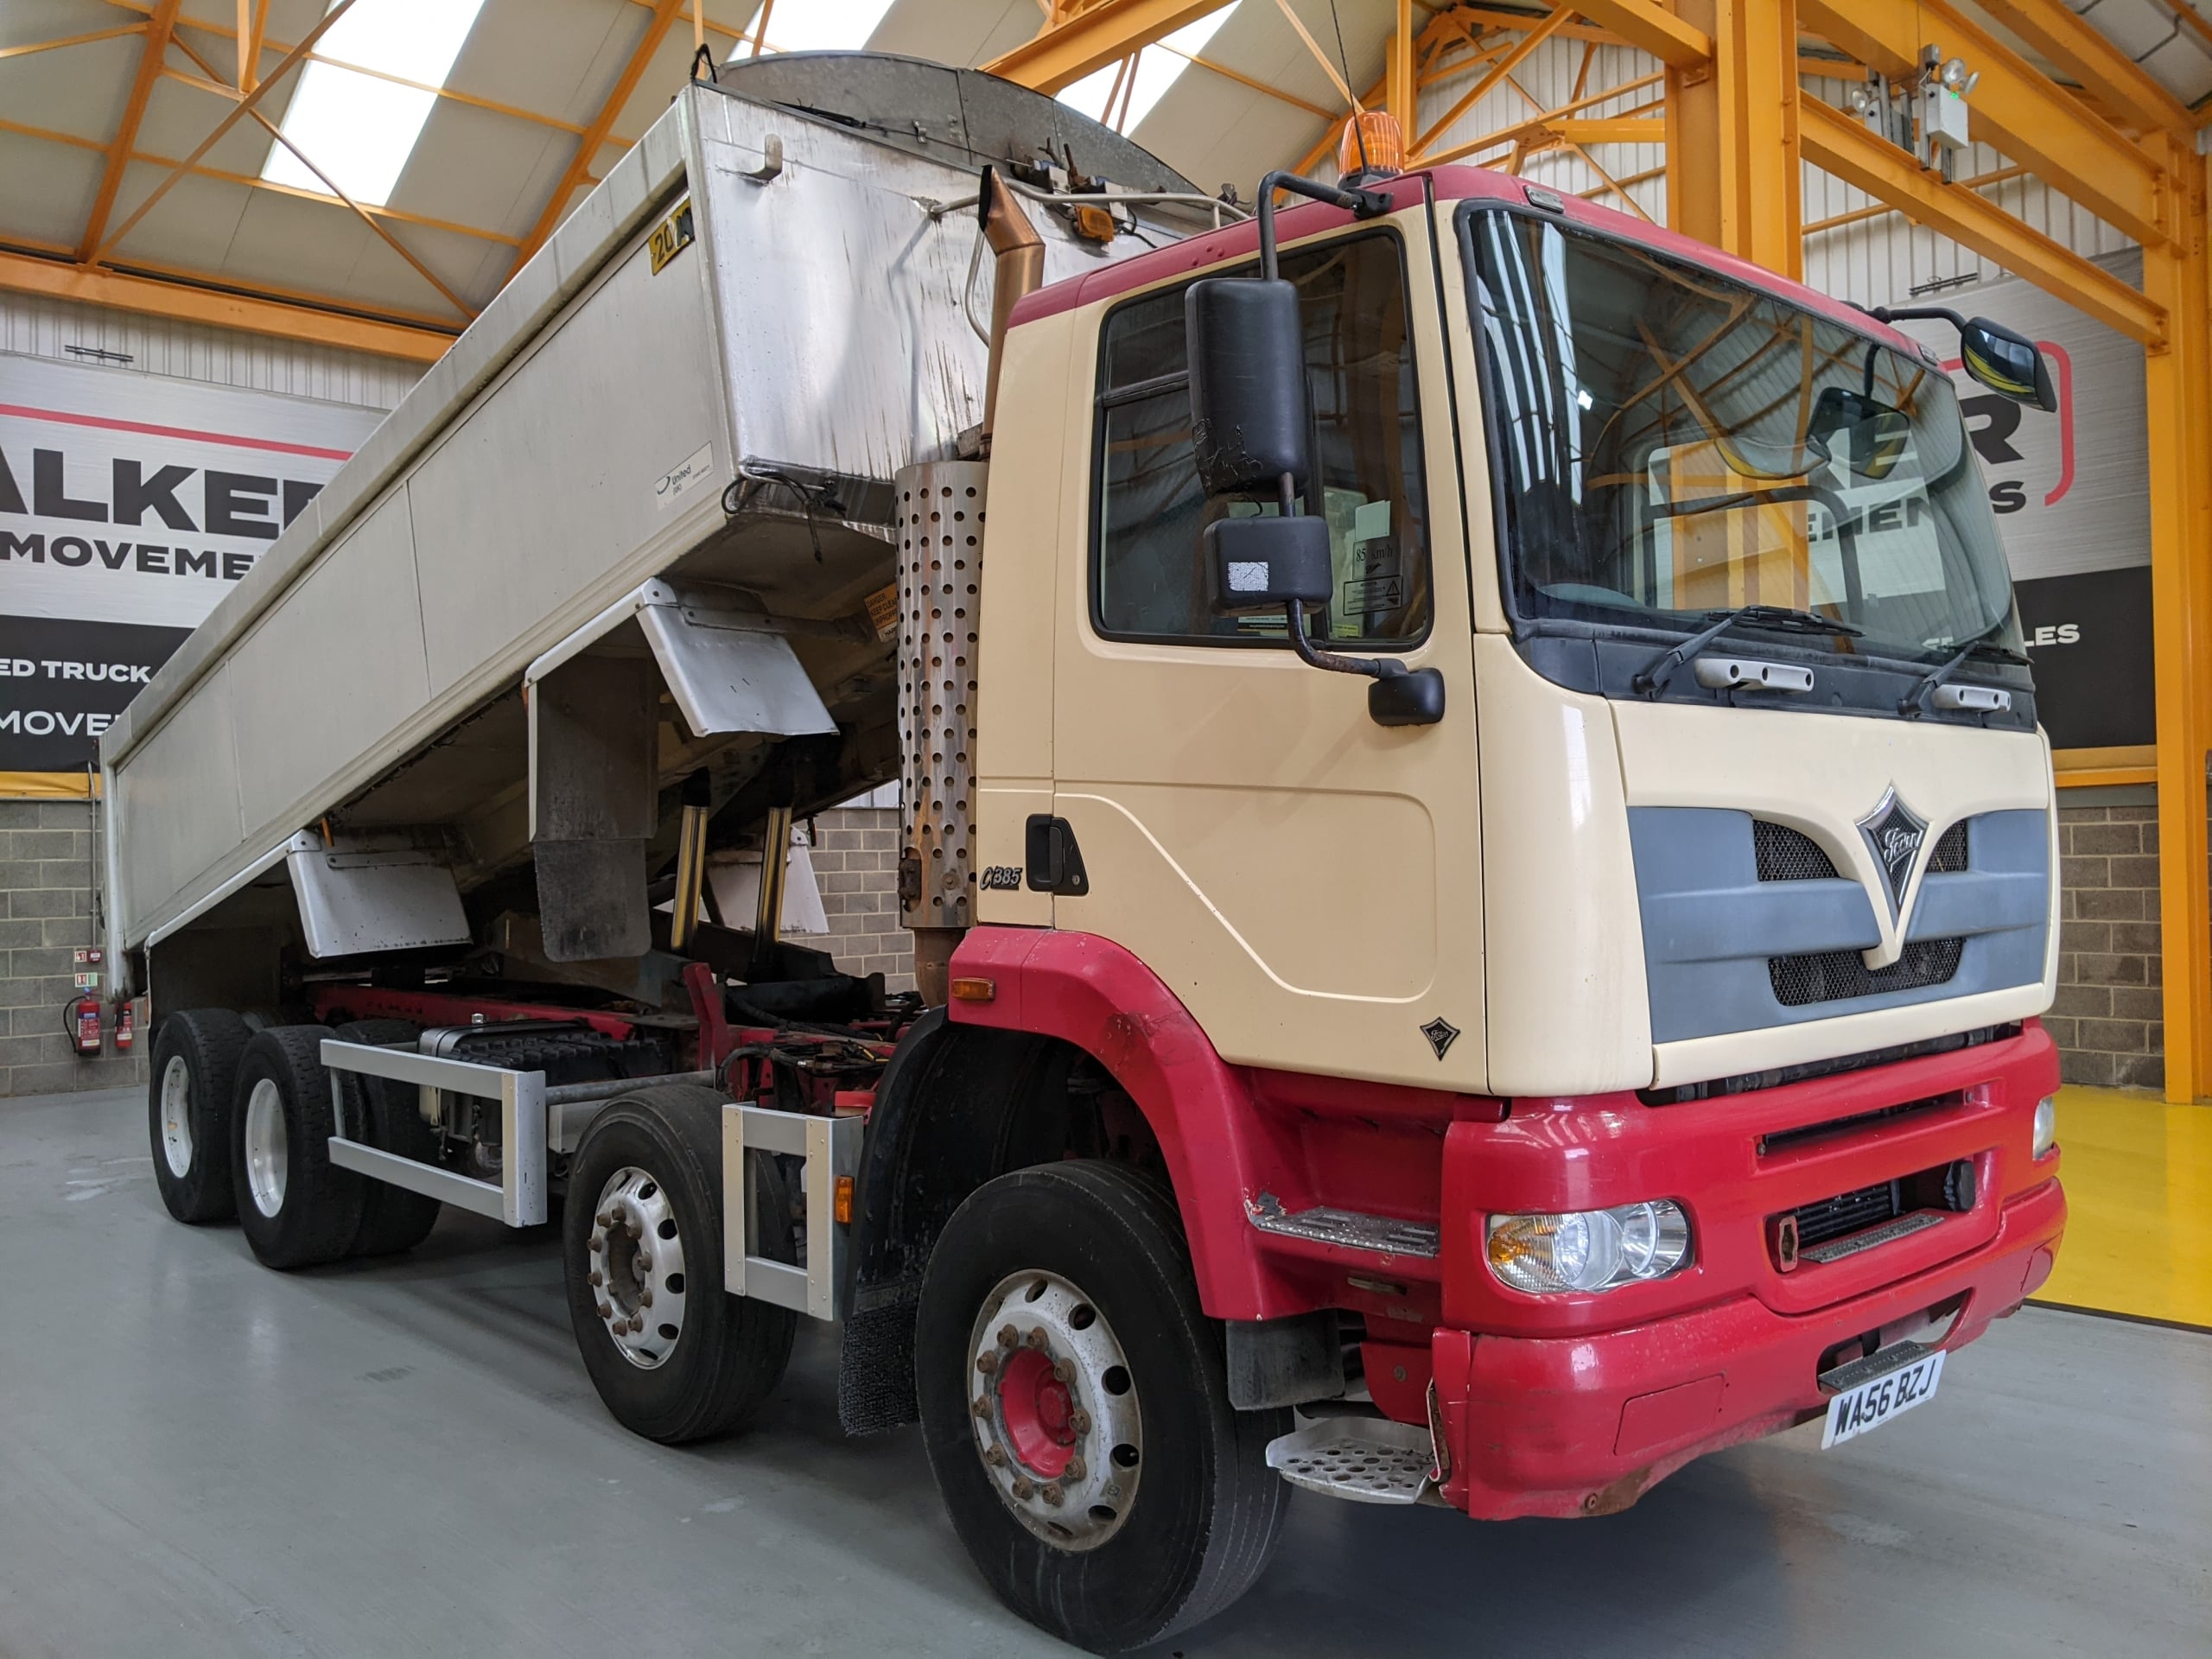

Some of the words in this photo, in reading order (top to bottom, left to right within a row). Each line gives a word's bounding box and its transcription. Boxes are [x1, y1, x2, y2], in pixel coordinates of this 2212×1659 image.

[41, 660, 152, 683] TRUCK
[1834, 1378, 1894, 1436] WA56
[1893, 1358, 1936, 1410] BZJ
